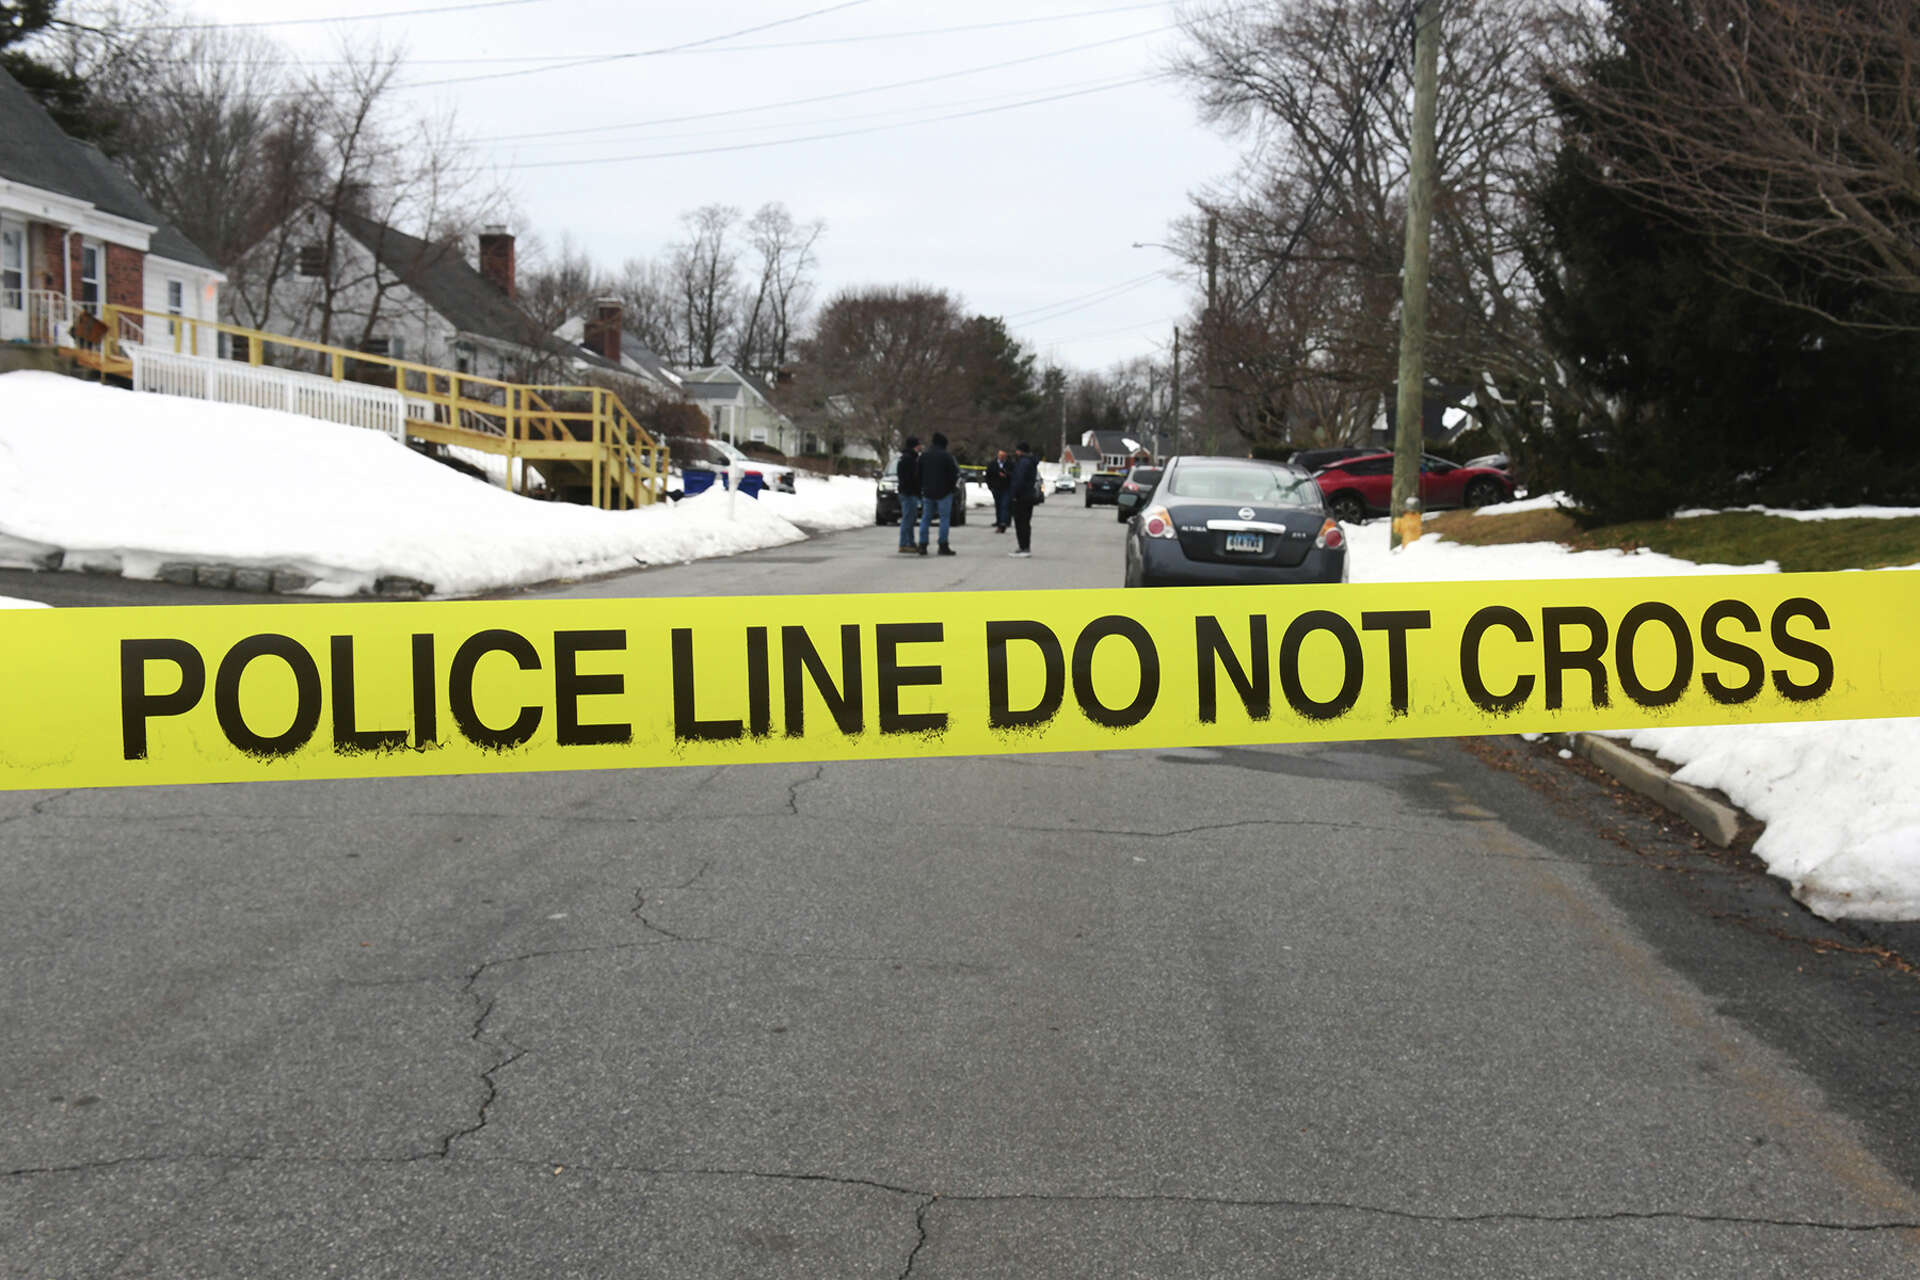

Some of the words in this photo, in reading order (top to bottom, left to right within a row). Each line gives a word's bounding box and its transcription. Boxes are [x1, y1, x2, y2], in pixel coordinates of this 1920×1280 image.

[121, 630, 632, 760] POLICE
[672, 623, 948, 745] LINE
[986, 616, 1160, 733] DO
[1196, 610, 1431, 723] NOT
[1460, 598, 1833, 718] CROSS
